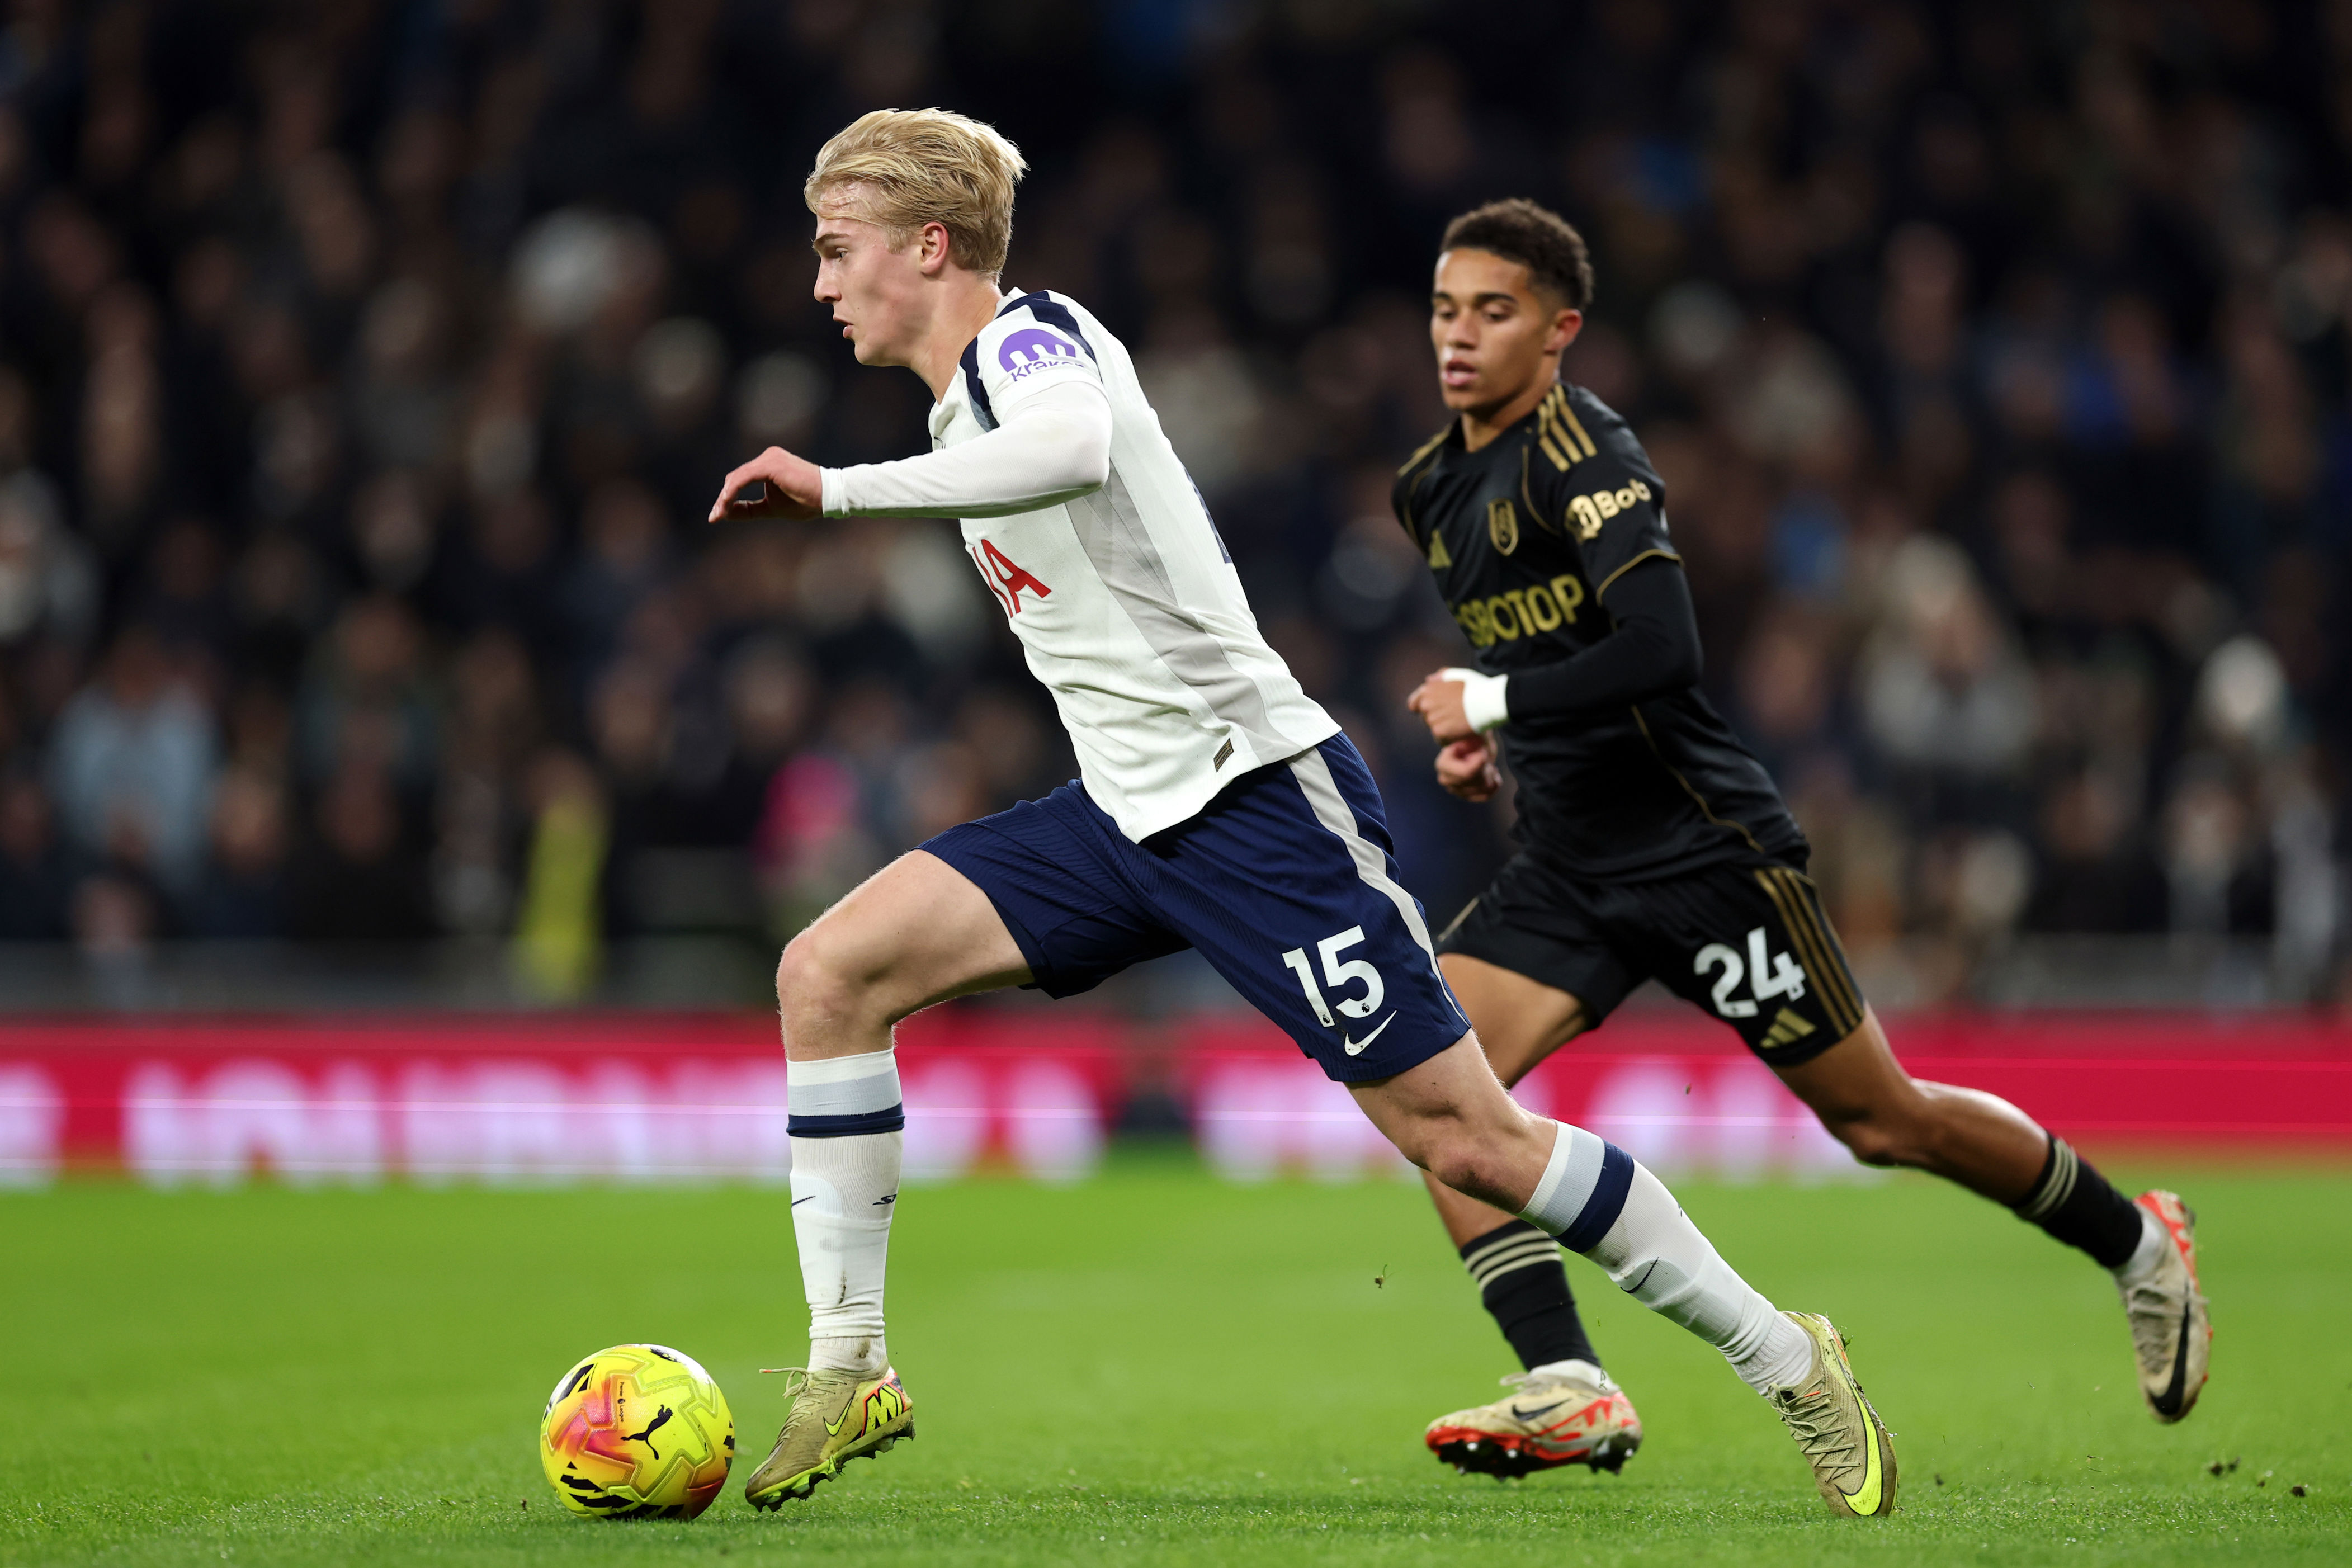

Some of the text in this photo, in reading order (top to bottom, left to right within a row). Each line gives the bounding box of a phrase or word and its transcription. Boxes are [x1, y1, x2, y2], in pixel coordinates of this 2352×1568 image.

[1591, 478, 1652, 520] Bob
[972, 539, 1052, 618] IA
[1282, 925, 1385, 1028] 15
[1693, 925, 1806, 1018] 24
